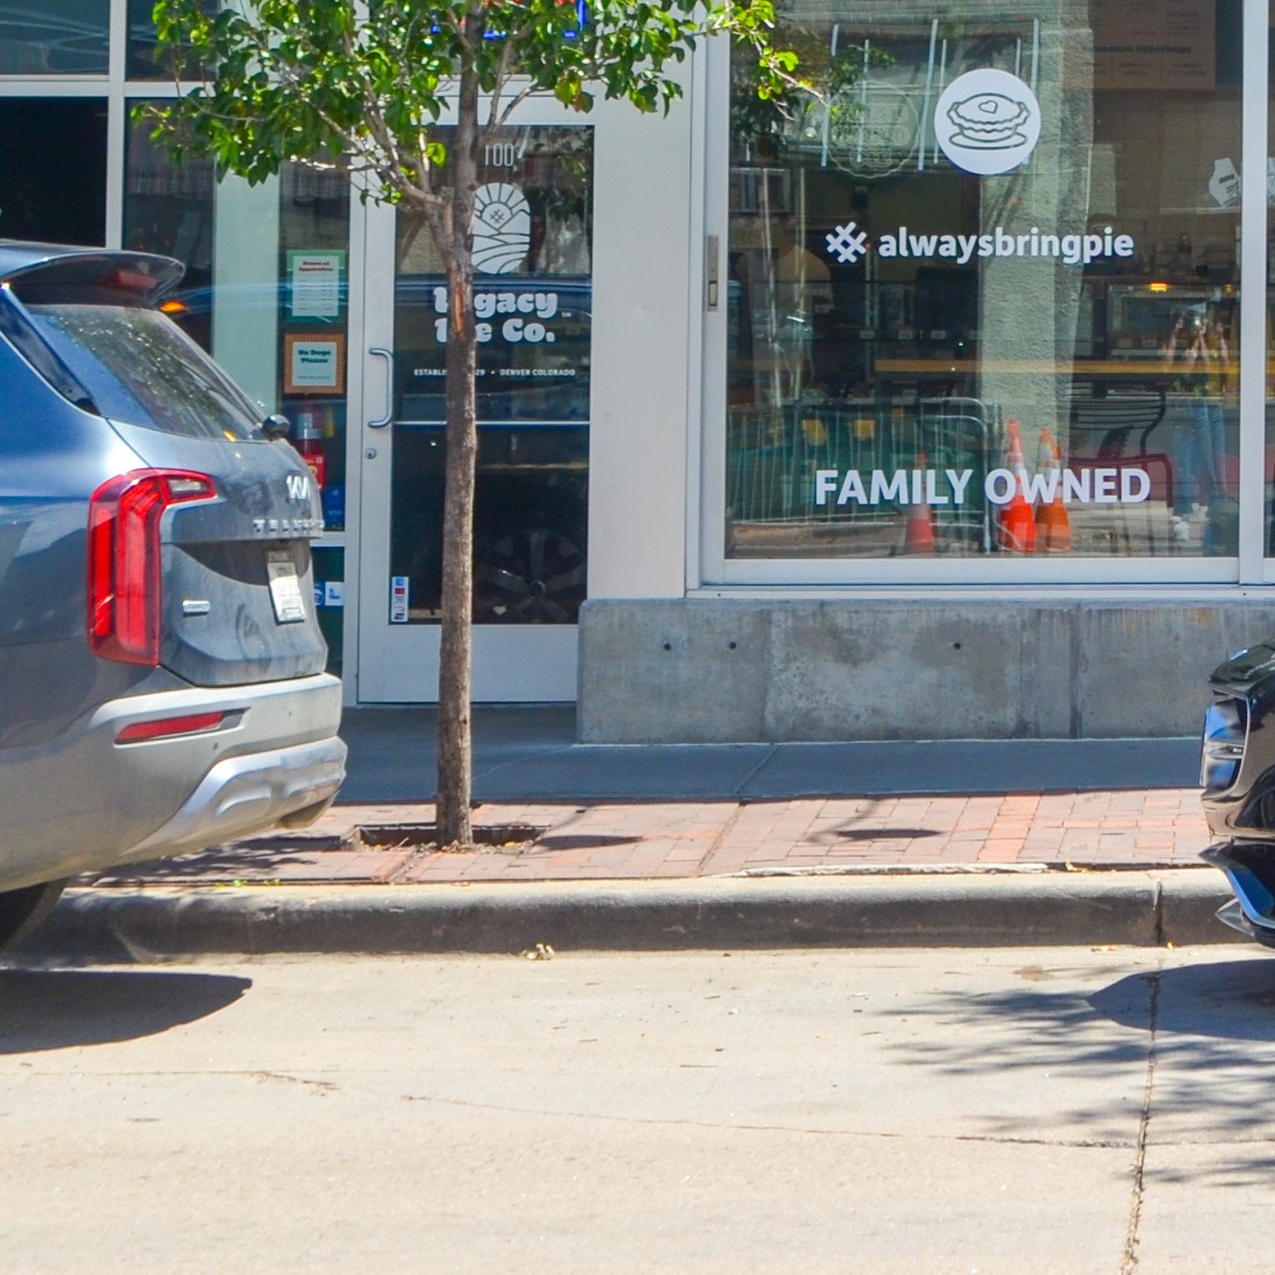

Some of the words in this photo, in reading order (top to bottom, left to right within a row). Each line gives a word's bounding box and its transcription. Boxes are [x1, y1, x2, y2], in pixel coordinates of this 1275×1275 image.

[879, 226, 1134, 264] alwaysbringpie
[433, 286, 558, 318] Lgacy
[502, 318, 555, 343] Co.
[816, 469, 974, 505] FAMILY
[986, 469, 1152, 505] OWNED
